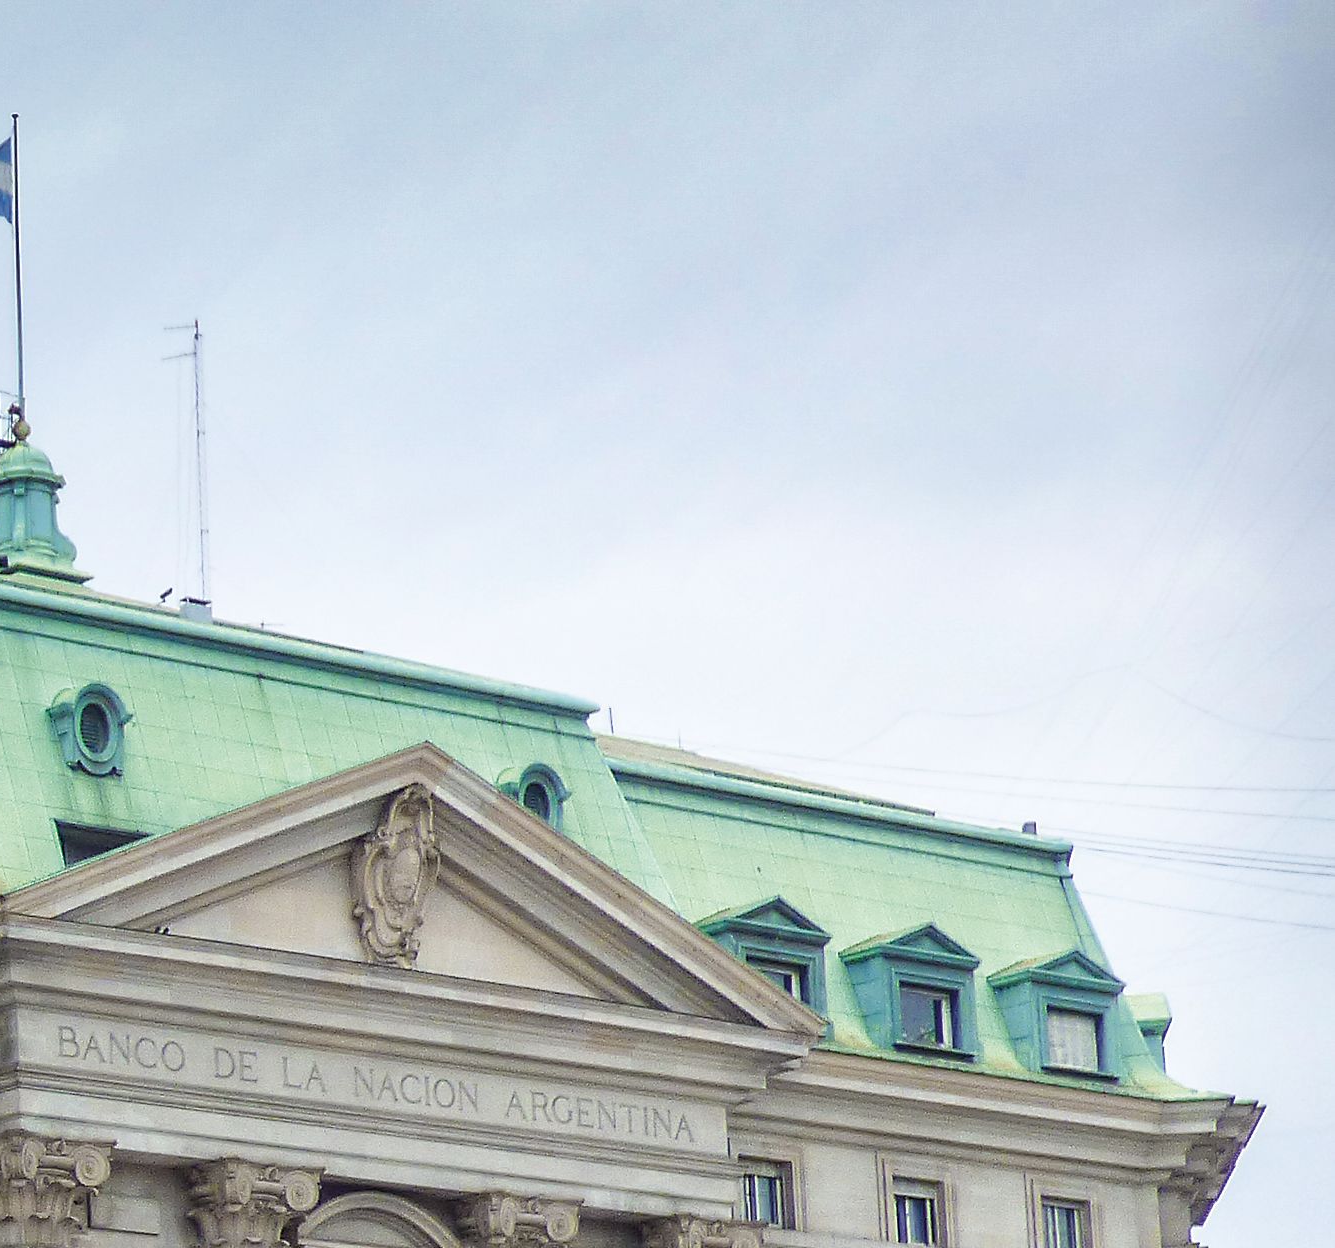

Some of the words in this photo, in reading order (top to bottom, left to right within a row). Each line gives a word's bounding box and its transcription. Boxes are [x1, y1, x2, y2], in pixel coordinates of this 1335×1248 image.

[57, 1025, 186, 1072] BANCO
[214, 1047, 259, 1083] DE
[282, 1056, 327, 1093] LA
[353, 1066, 479, 1113] NACION
[504, 1090, 695, 1144] ARGENTINA
